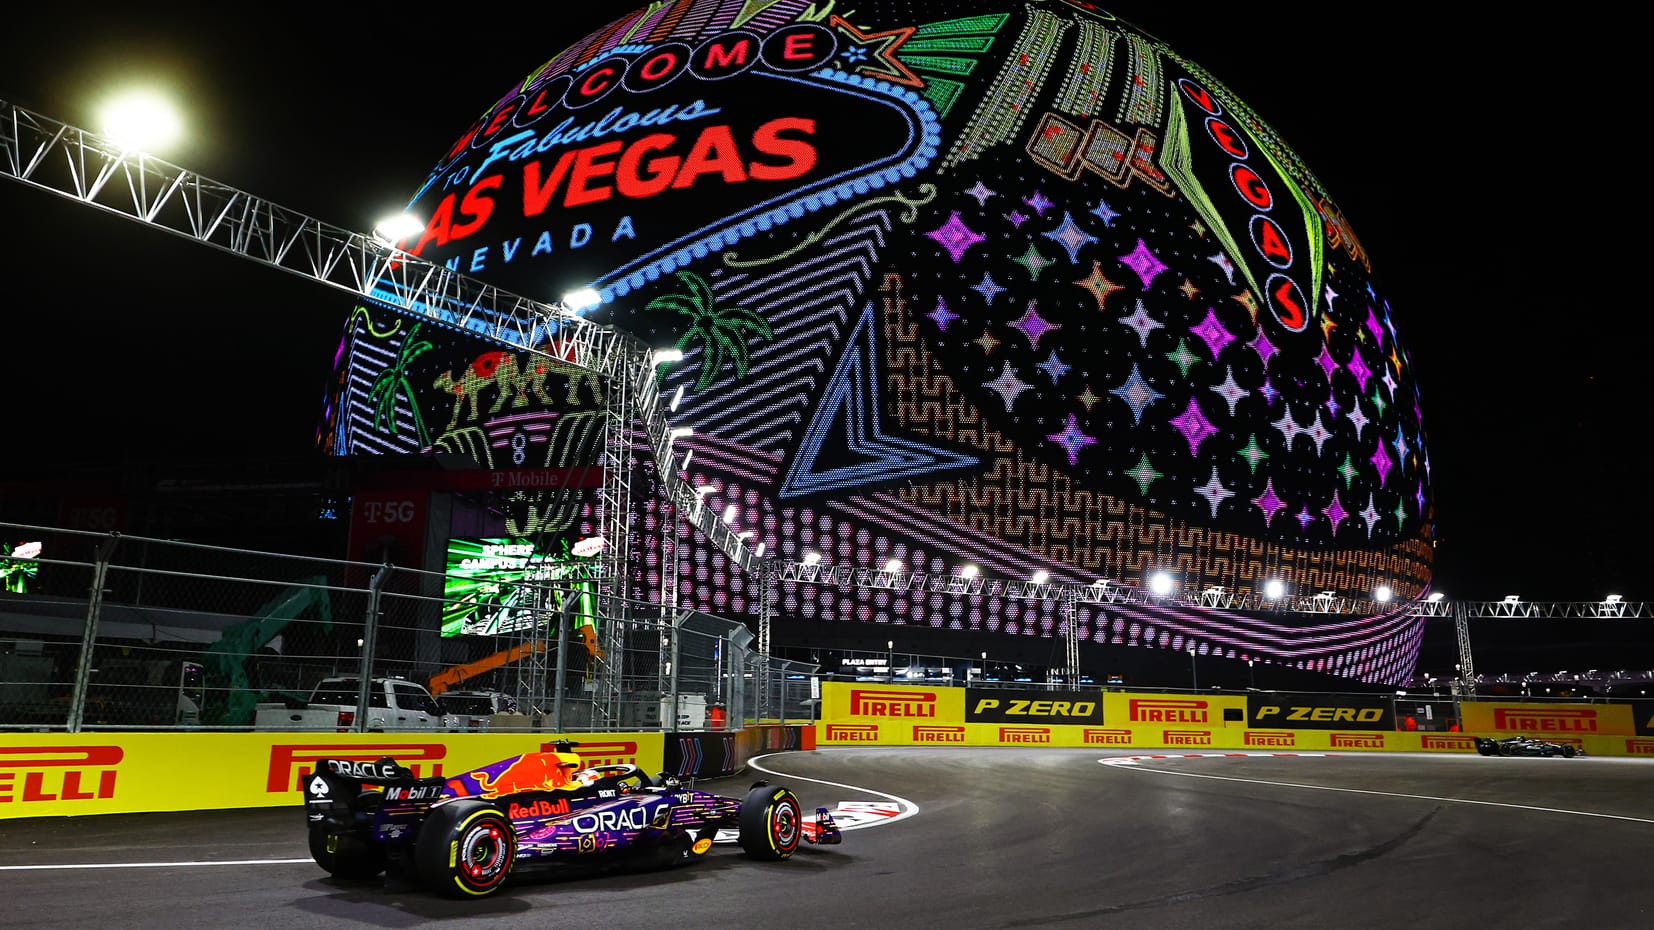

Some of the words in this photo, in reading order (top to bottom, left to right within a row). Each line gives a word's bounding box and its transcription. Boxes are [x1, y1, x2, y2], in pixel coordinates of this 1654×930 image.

[449, 33, 816, 159] WELCOME
[443, 165, 470, 191] TO
[469, 99, 721, 186] Fabulous
[523, 117, 817, 217] VEGAS
[1182, 84, 1304, 330] VEGAS
[443, 215, 637, 276] NEVADA
[508, 471, 558, 486] Mobile
[851, 689, 937, 718] PIRELLI
[974, 699, 1000, 714] P
[1005, 700, 1096, 717] ZERO
[1129, 699, 1208, 723] PIRELLI
[1255, 706, 1282, 720] P
[1287, 707, 1384, 722] ZERO
[1494, 708, 1598, 732] PIRELLI
[826, 724, 879, 741] PIRELLI
[913, 725, 965, 742] PIRELLI
[999, 727, 1050, 743] PIRELLI
[1083, 728, 1132, 744] PIRELLI
[1163, 730, 1211, 745] PIRELLI
[1244, 731, 1295, 747] PIRELLI
[1330, 733, 1384, 748] PIRELLI
[1421, 735, 1476, 750] PIRELL
[328, 759, 397, 779] ORACLE
[386, 786, 427, 801] Mobil
